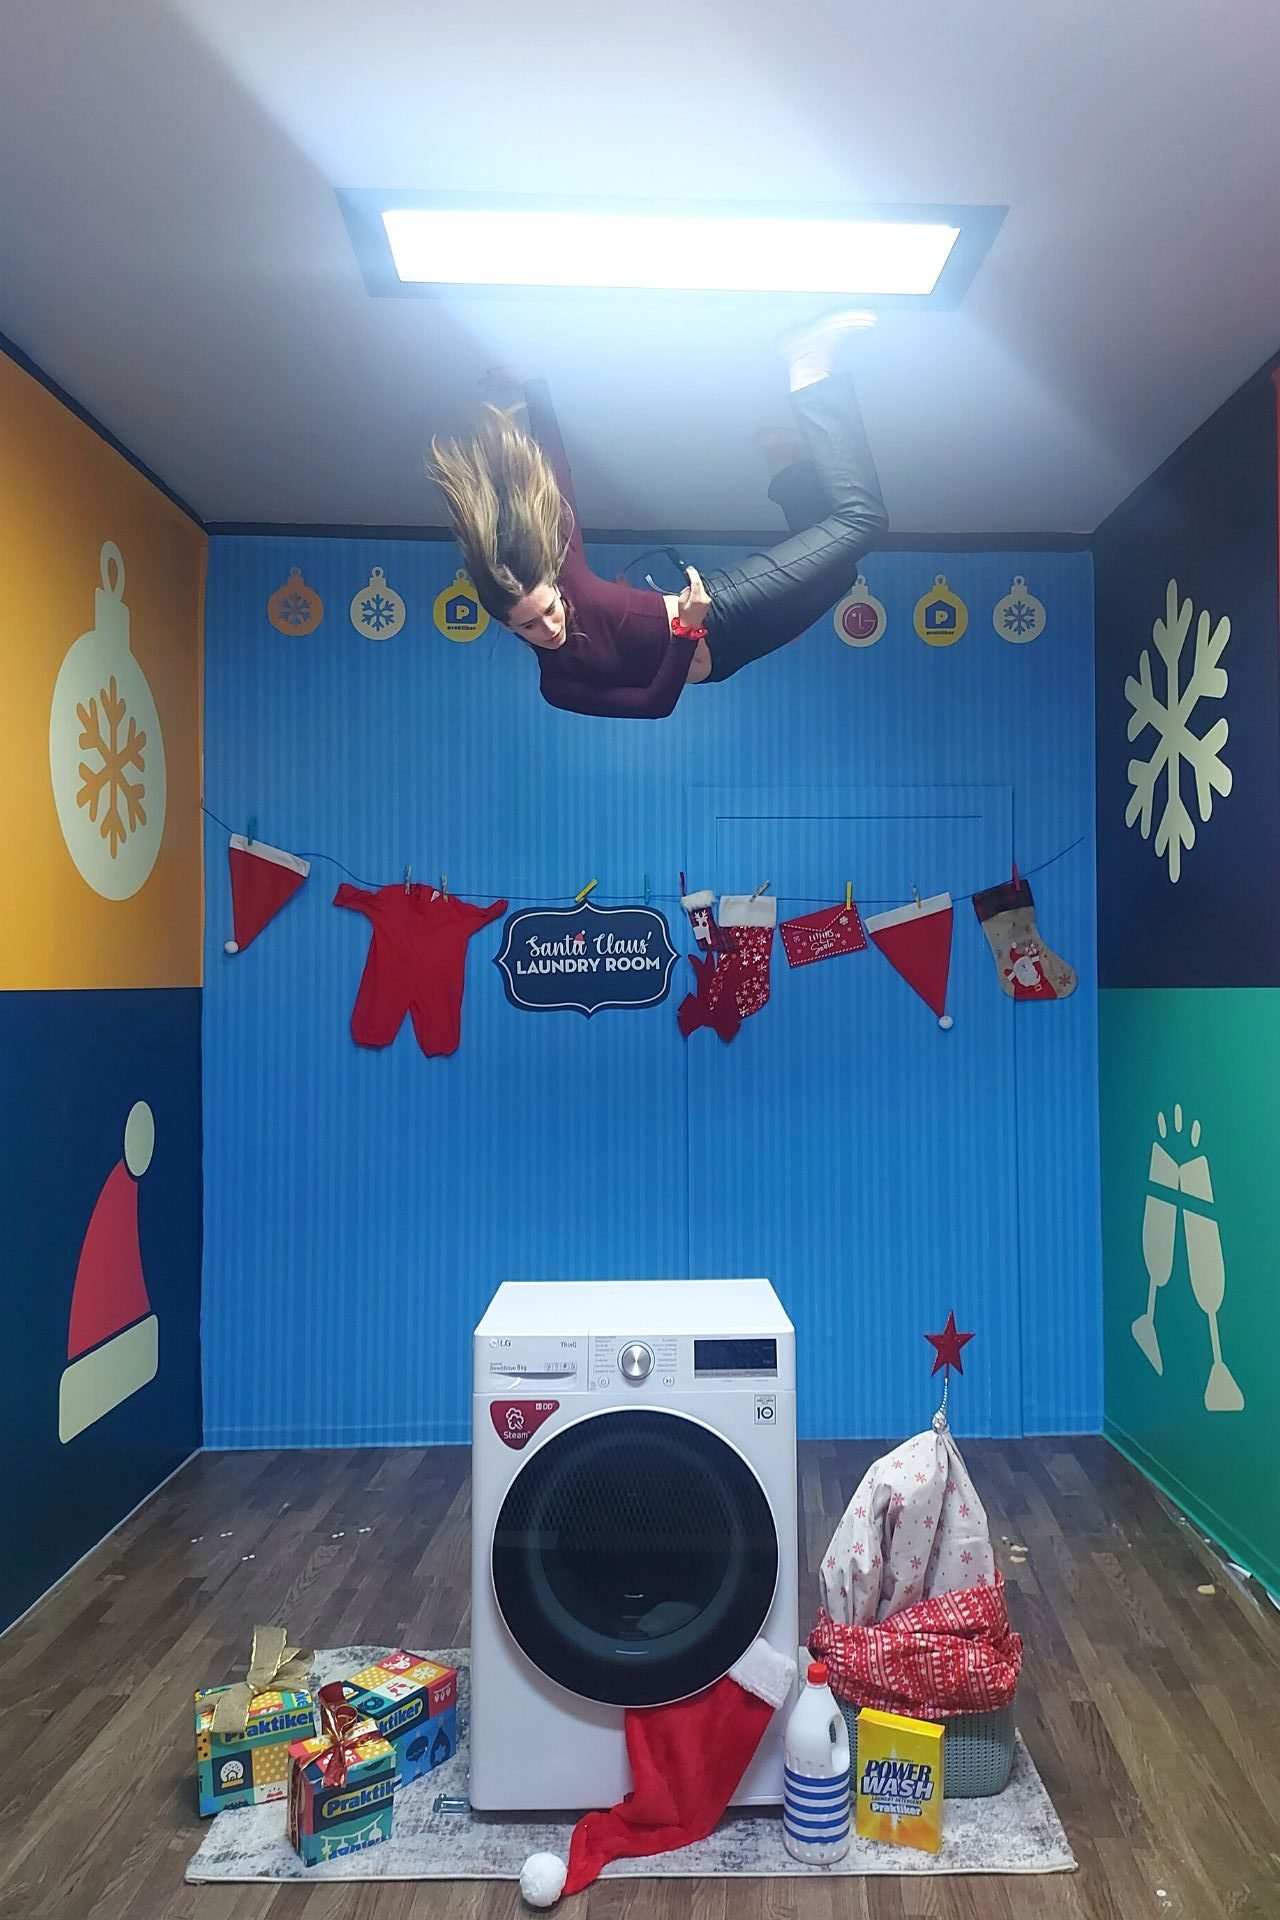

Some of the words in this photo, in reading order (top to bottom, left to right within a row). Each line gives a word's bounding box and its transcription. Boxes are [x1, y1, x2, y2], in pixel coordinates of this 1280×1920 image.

[526, 933, 587, 957] Santa
[592, 931, 652, 955] Claus'
[516, 957, 602, 975] LAUNDRY
[605, 956, 661, 972] ROOM
[500, 1339, 511, 1347] LG
[503, 1431, 530, 1440] Steam
[379, 1701, 421, 1734] ktiker
[865, 1760, 932, 1782] POWER
[862, 1776, 934, 1800] WASH
[872, 1803, 921, 1815] Praktiker
